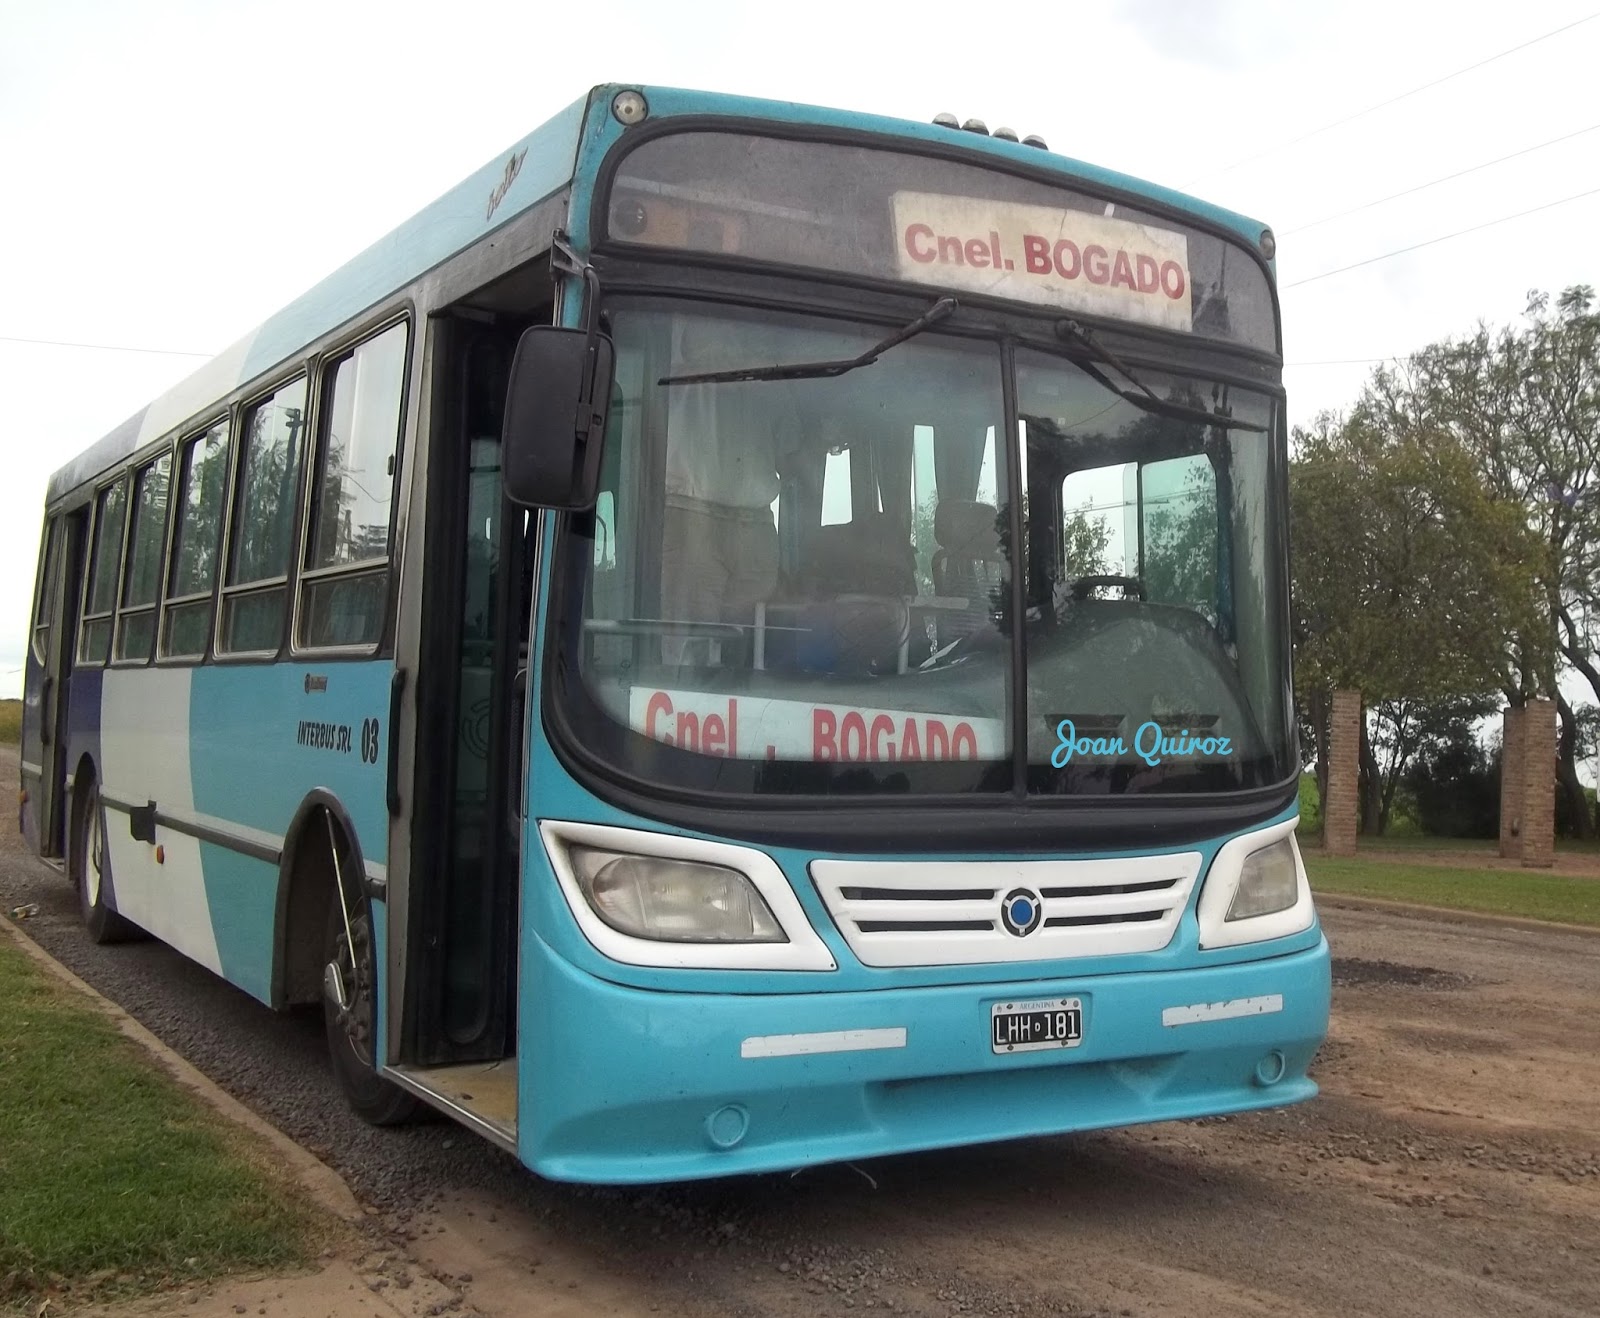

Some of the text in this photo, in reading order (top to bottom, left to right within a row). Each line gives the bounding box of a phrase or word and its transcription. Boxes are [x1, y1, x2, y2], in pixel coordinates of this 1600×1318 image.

[905, 223, 1185, 300] Cnel. BOGADO
[297, 717, 379, 764] INTERBUS SRL 03
[813, 708, 978, 762] BOGADO
[1019, 1001, 1055, 1011] ARGENTINA
[1044, 1011, 1079, 1040] 181
